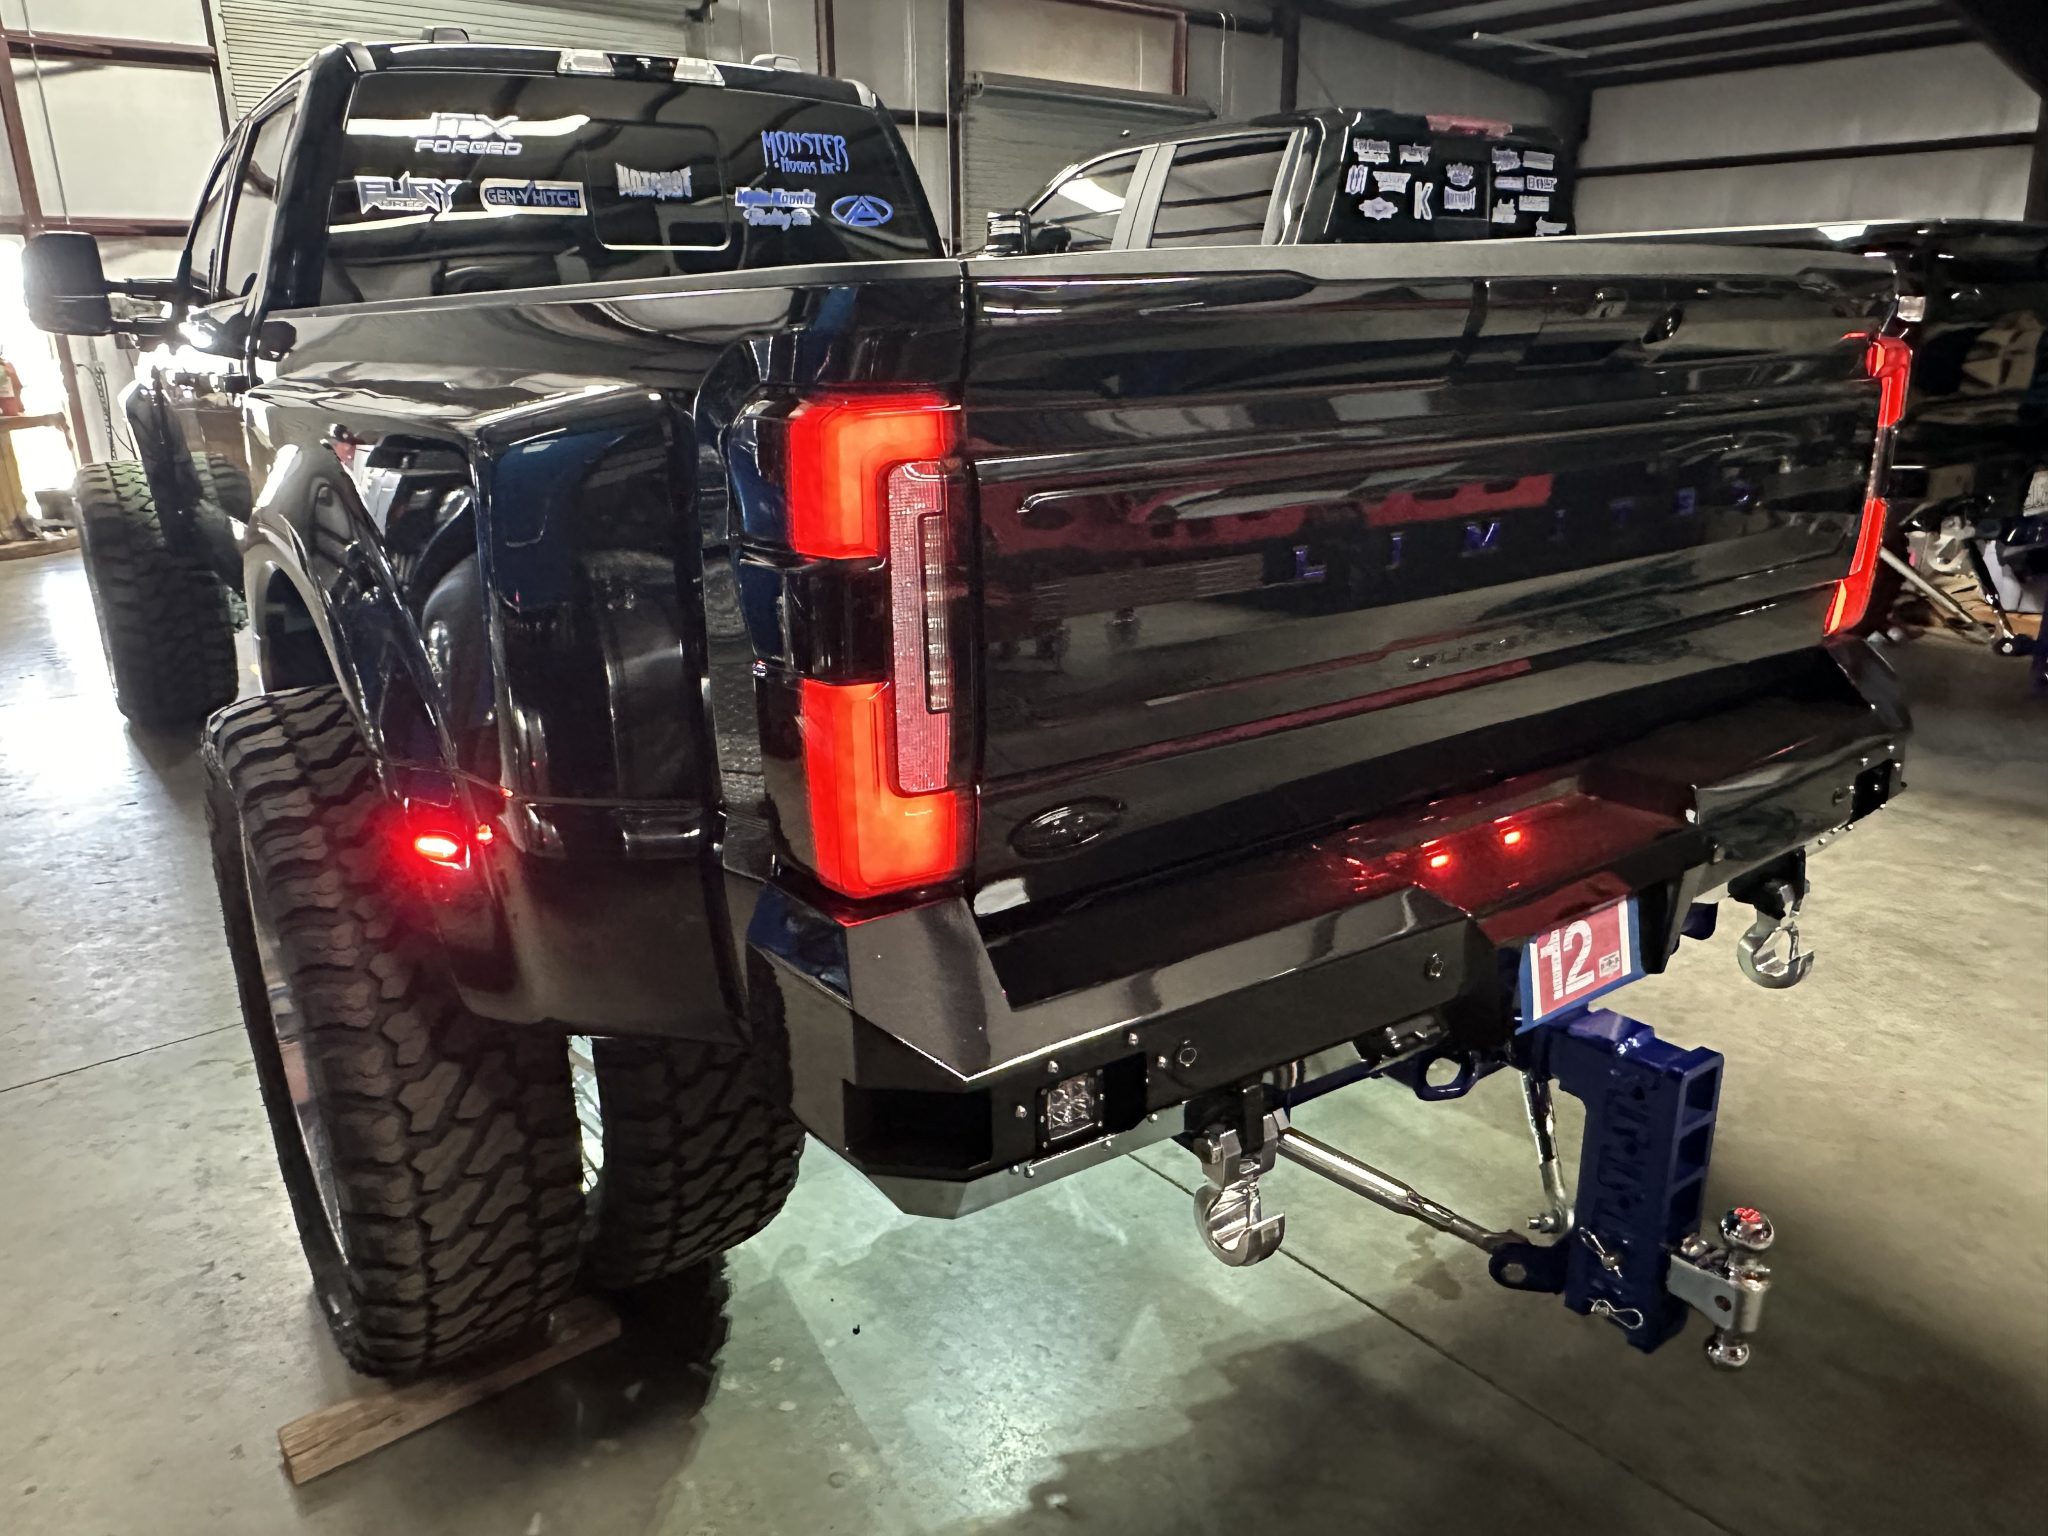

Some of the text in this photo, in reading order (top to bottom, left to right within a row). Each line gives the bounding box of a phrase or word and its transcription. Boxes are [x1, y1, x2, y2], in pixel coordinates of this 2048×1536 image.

[415, 139, 522, 155] FORGED
[761, 130, 849, 173] MONSTER
[355, 171, 462, 214] FURY
[486, 180, 579, 206] GEN-Y HITCH
[1540, 919, 1595, 1000] 12
